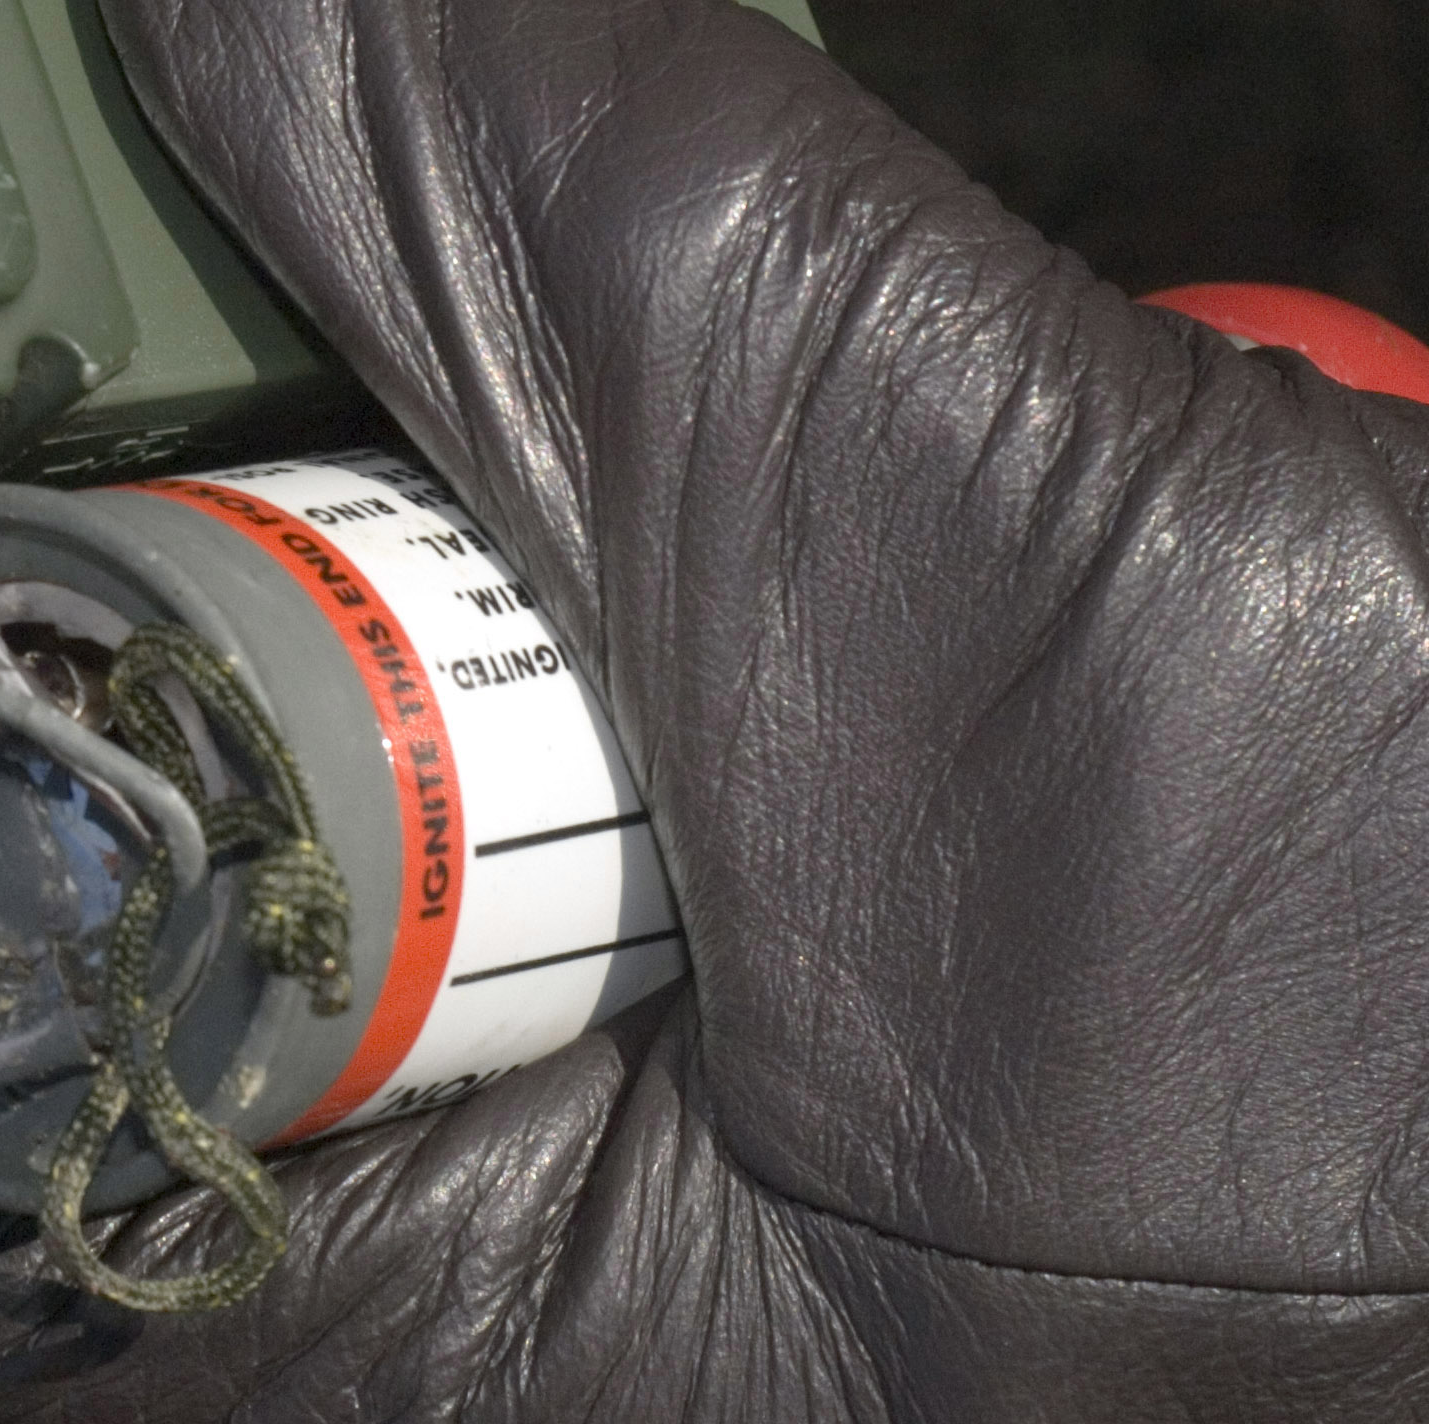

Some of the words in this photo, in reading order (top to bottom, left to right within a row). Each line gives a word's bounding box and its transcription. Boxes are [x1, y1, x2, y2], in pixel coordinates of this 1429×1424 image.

[304, 497, 398, 525] RING
[399, 487, 455, 509] SH
[281, 532, 367, 608] END
[405, 529, 490, 560] EAL.
[357, 619, 425, 725] THIS
[408, 739, 450, 921] IGNITE
